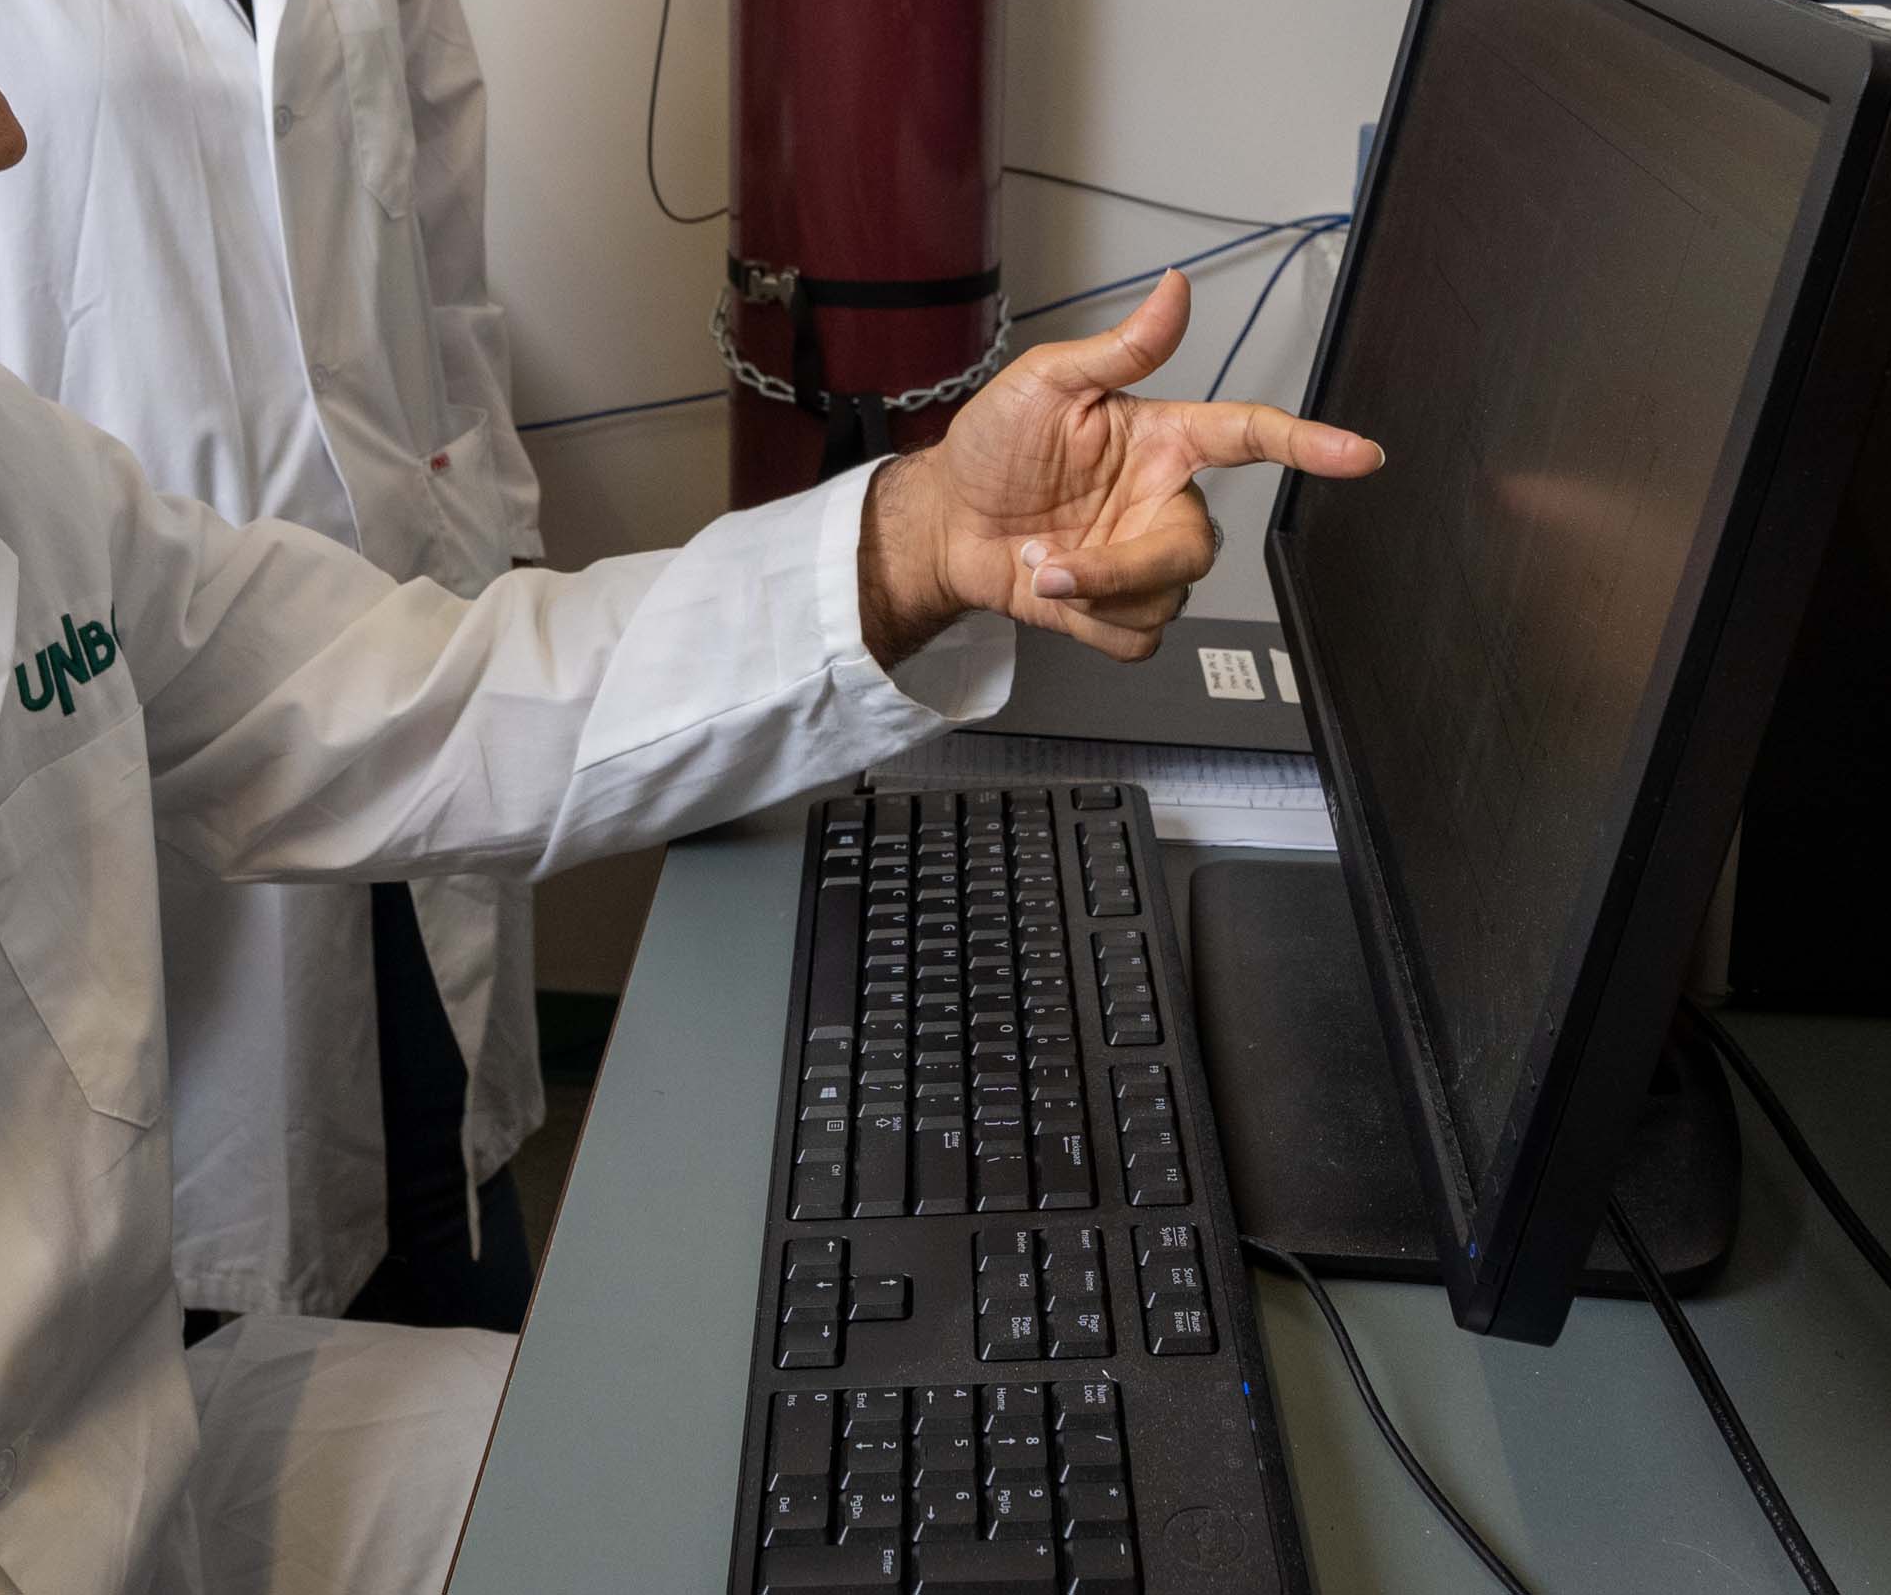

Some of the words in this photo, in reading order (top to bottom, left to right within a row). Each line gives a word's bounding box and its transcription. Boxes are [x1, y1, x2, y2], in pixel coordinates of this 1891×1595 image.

[14, 601, 122, 717] UNB
[986, 822, 1000, 830] Q
[941, 830, 954, 838] A
[989, 844, 1001, 854] W
[892, 889, 906, 897] C
[892, 914, 905, 922] V
[942, 923, 956, 932] G
[995, 940, 1008, 949] Y
[891, 966, 904, 974] N
[996, 967, 1010, 976] U
[891, 993, 904, 1002] M
[944, 1005, 958, 1013] K
[999, 1024, 1014, 1033] O
[944, 1033, 959, 1041] L
[1155, 1098, 1166, 1110] F10
[892, 1116, 902, 1132] Shift
[951, 1131, 961, 1148] Enter
[1160, 1132, 1171, 1145] F11
[1071, 1134, 1082, 1166] Backspace
[831, 1164, 841, 1176] Ctrl
[1166, 1168, 1178, 1182] F12
[1016, 1231, 1027, 1253] Delete
[1081, 1229, 1091, 1249] Insert
[1160, 1227, 1172, 1247] SysRq
[1177, 1226, 1188, 1247] PrtScn
[1019, 1273, 1029, 1287] End
[1085, 1270, 1094, 1291] Home
[1171, 1267, 1182, 1285] Lock
[1183, 1267, 1197, 1287] Scroll
[1021, 1316, 1032, 1335] Page
[1078, 1314, 1087, 1326] Up
[1088, 1314, 1100, 1333] Page
[1174, 1311, 1184, 1332] Break
[1190, 1311, 1201, 1332] Pause
[1011, 1316, 1021, 1338] Down
[954, 1389, 967, 1398] 4
[1023, 1386, 1038, 1394] 7
[1084, 1384, 1094, 1403] Lock
[1097, 1384, 1107, 1403] Num
[787, 1394, 798, 1407] Ins
[814, 1393, 828, 1401] 0
[856, 1392, 867, 1408] End
[996, 1387, 1006, 1411] Home
[882, 1441, 897, 1449] 2
[954, 1439, 969, 1447] 5
[1025, 1437, 1040, 1445] 8
[880, 1494, 895, 1502] 3
[955, 1491, 970, 1500] 6
[1029, 1489, 1044, 1498] 9
[779, 1497, 790, 1512] Del
[849, 1494, 864, 1519] PgDn
[997, 1489, 1011, 1514] PgUp
[882, 1549, 895, 1575] Enter
